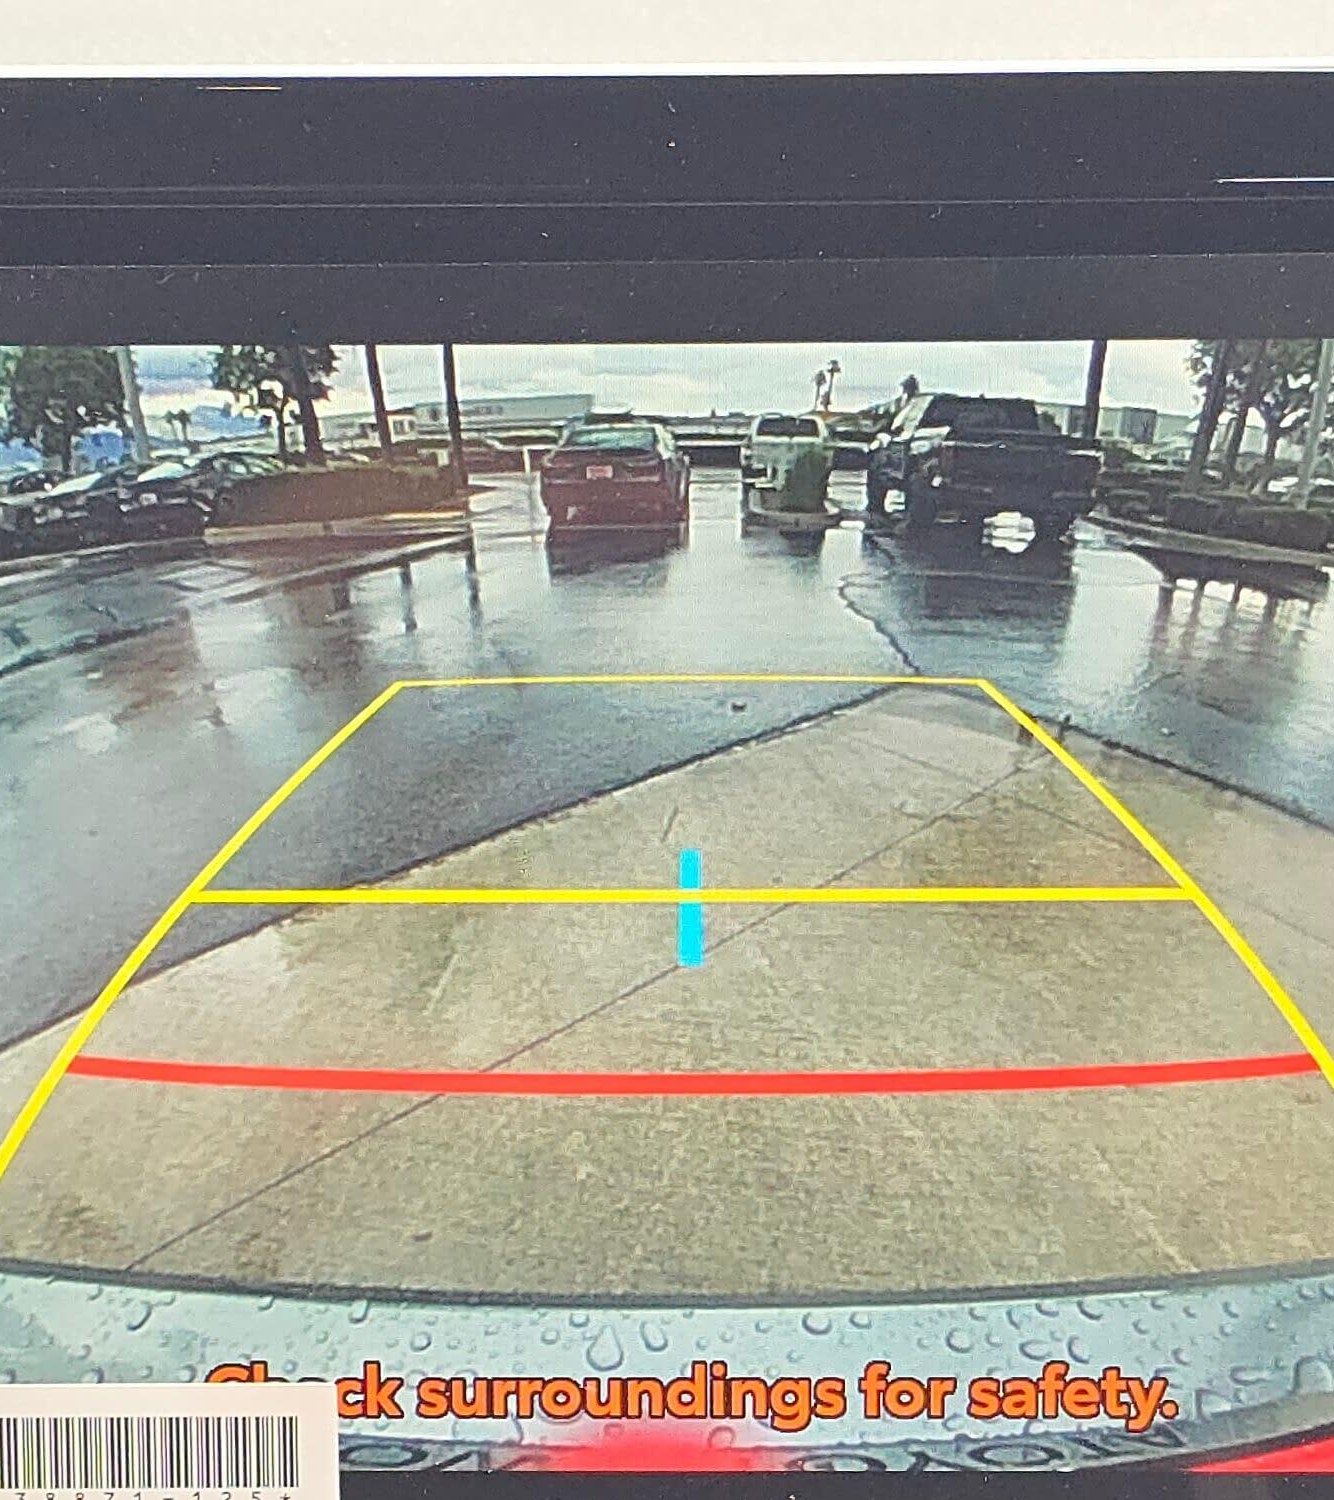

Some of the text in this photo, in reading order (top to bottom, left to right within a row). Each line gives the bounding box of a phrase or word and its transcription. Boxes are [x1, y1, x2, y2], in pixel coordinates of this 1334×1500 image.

[416, 1361, 849, 1433] surroundings
[859, 1361, 958, 1421] for
[968, 1362, 1179, 1432] safety.
